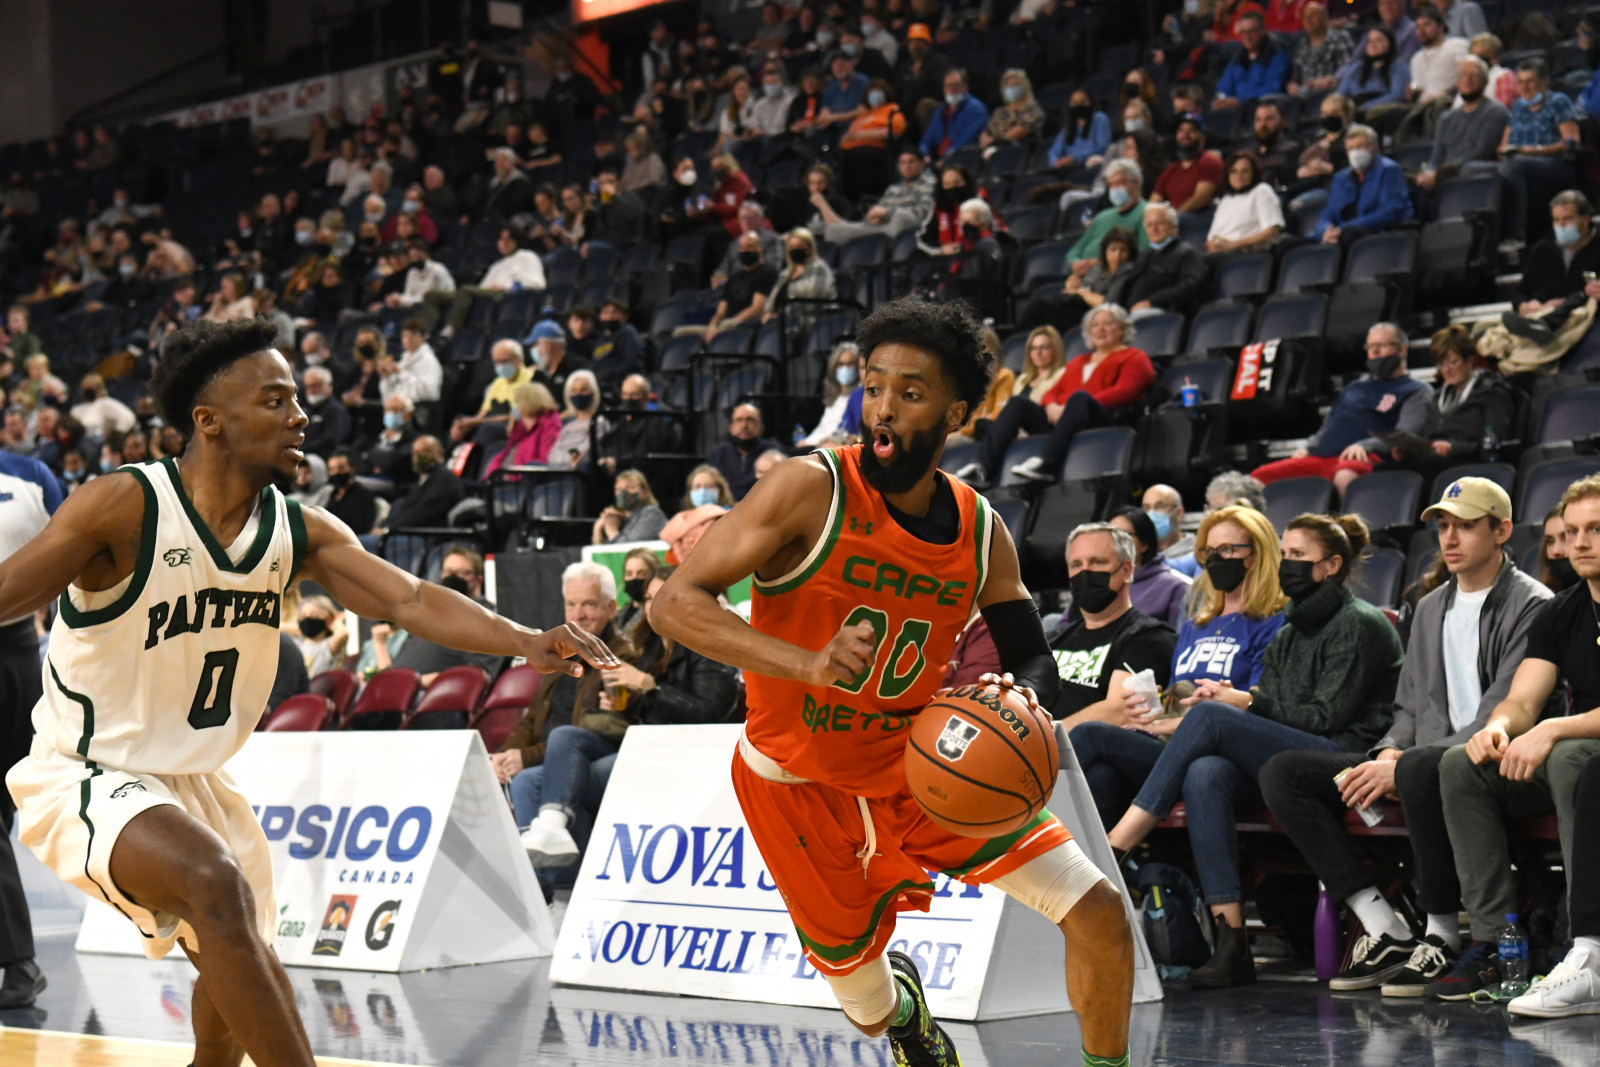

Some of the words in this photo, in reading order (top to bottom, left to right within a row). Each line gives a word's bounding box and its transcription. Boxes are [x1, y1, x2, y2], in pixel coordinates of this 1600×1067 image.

[842, 556, 967, 606] CAPE
[1175, 642, 1241, 678] UPEI
[187, 647, 239, 730] 0
[941, 730, 969, 749] SPORTS
[252, 804, 433, 863] PSICO
[596, 823, 746, 888] NOVA
[338, 869, 414, 884] CANADA
